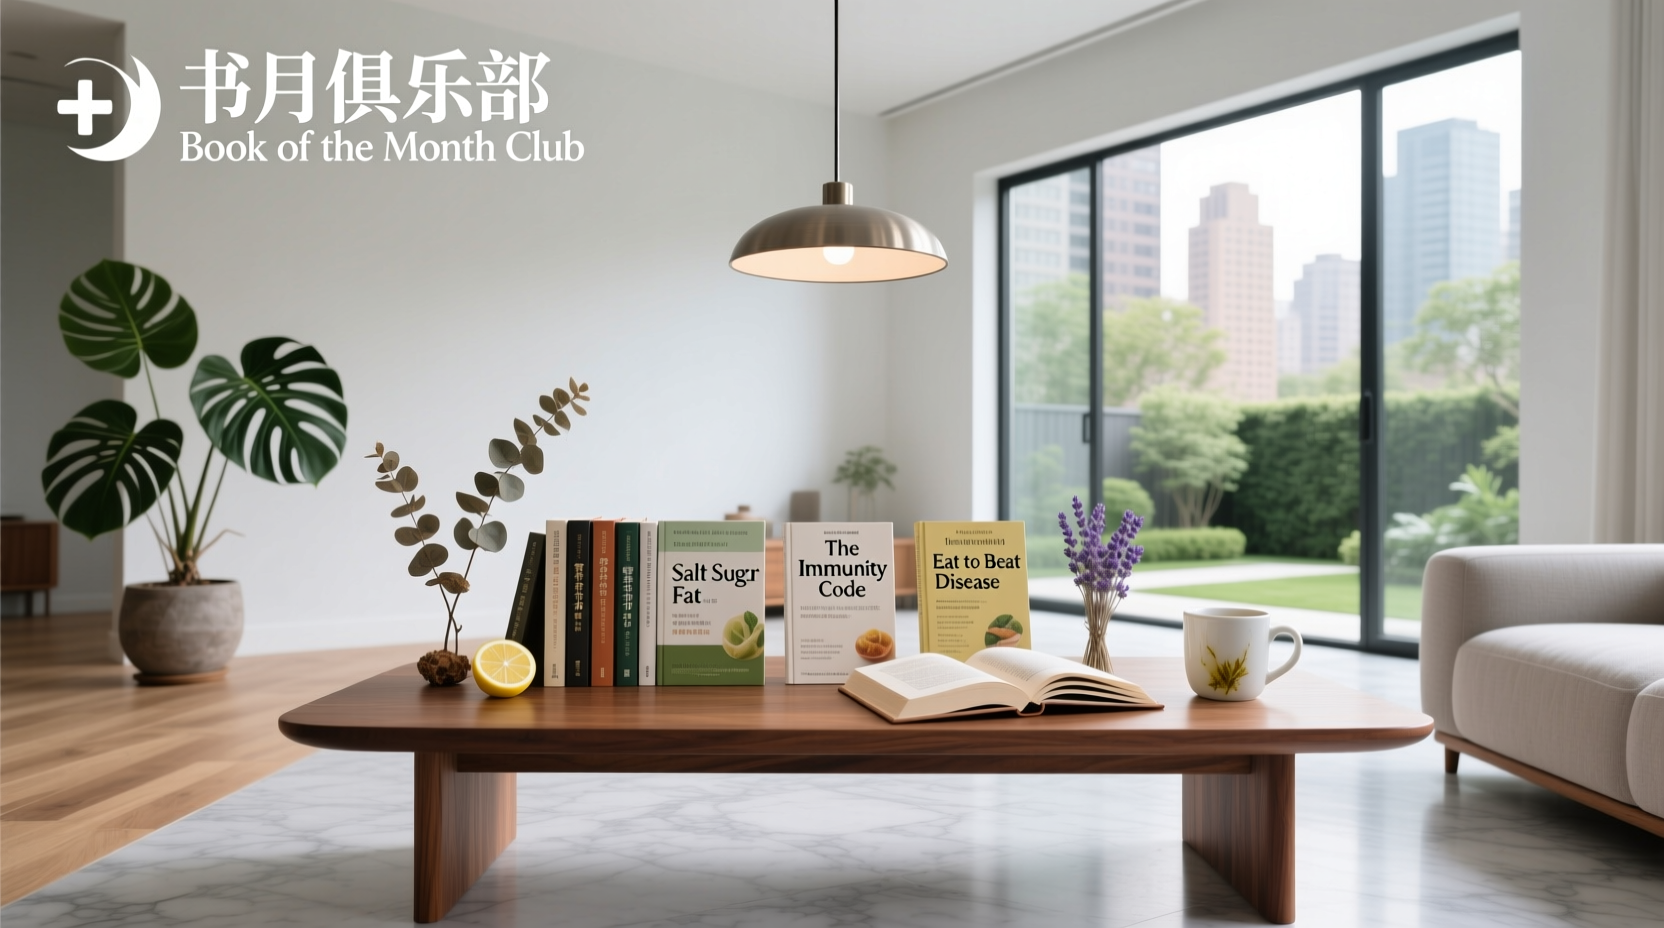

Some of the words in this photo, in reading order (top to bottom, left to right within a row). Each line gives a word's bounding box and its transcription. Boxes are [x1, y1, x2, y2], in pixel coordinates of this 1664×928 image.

[824, 539, 860, 556] The
[798, 559, 888, 582] Immunity
[932, 553, 960, 570] Eat
[963, 555, 981, 569] to
[984, 553, 1021, 569] Beat
[671, 562, 708, 582] Salt
[935, 573, 1000, 590] Disease
[672, 585, 702, 604] Fat
[818, 579, 866, 598] Code
